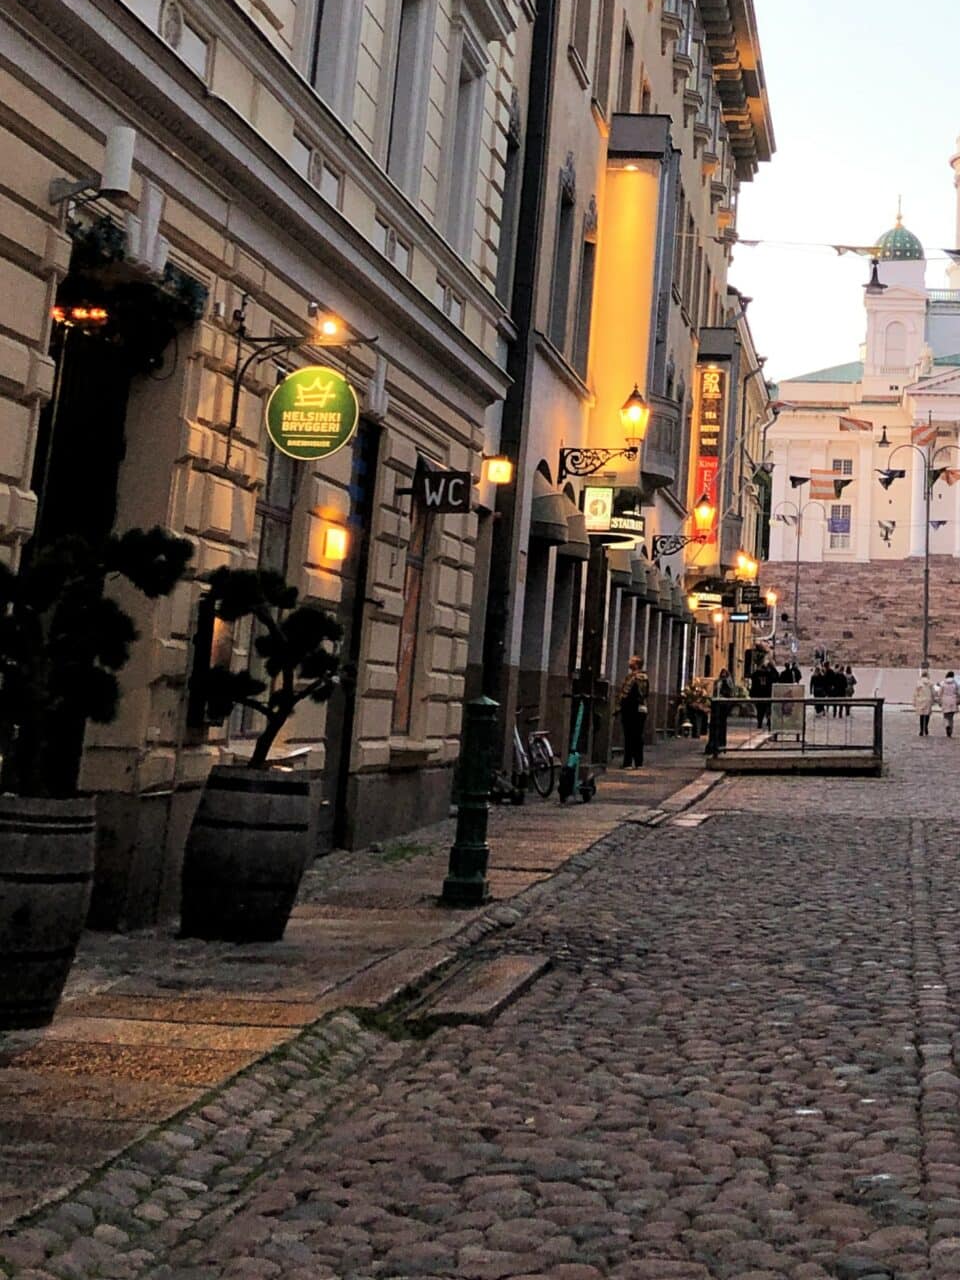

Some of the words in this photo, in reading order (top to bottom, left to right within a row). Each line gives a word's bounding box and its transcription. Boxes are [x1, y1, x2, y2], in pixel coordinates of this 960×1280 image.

[282, 411, 341, 422] HELSINKI
[281, 421, 340, 432] BRYGGERI
[424, 478, 464, 506] WC
